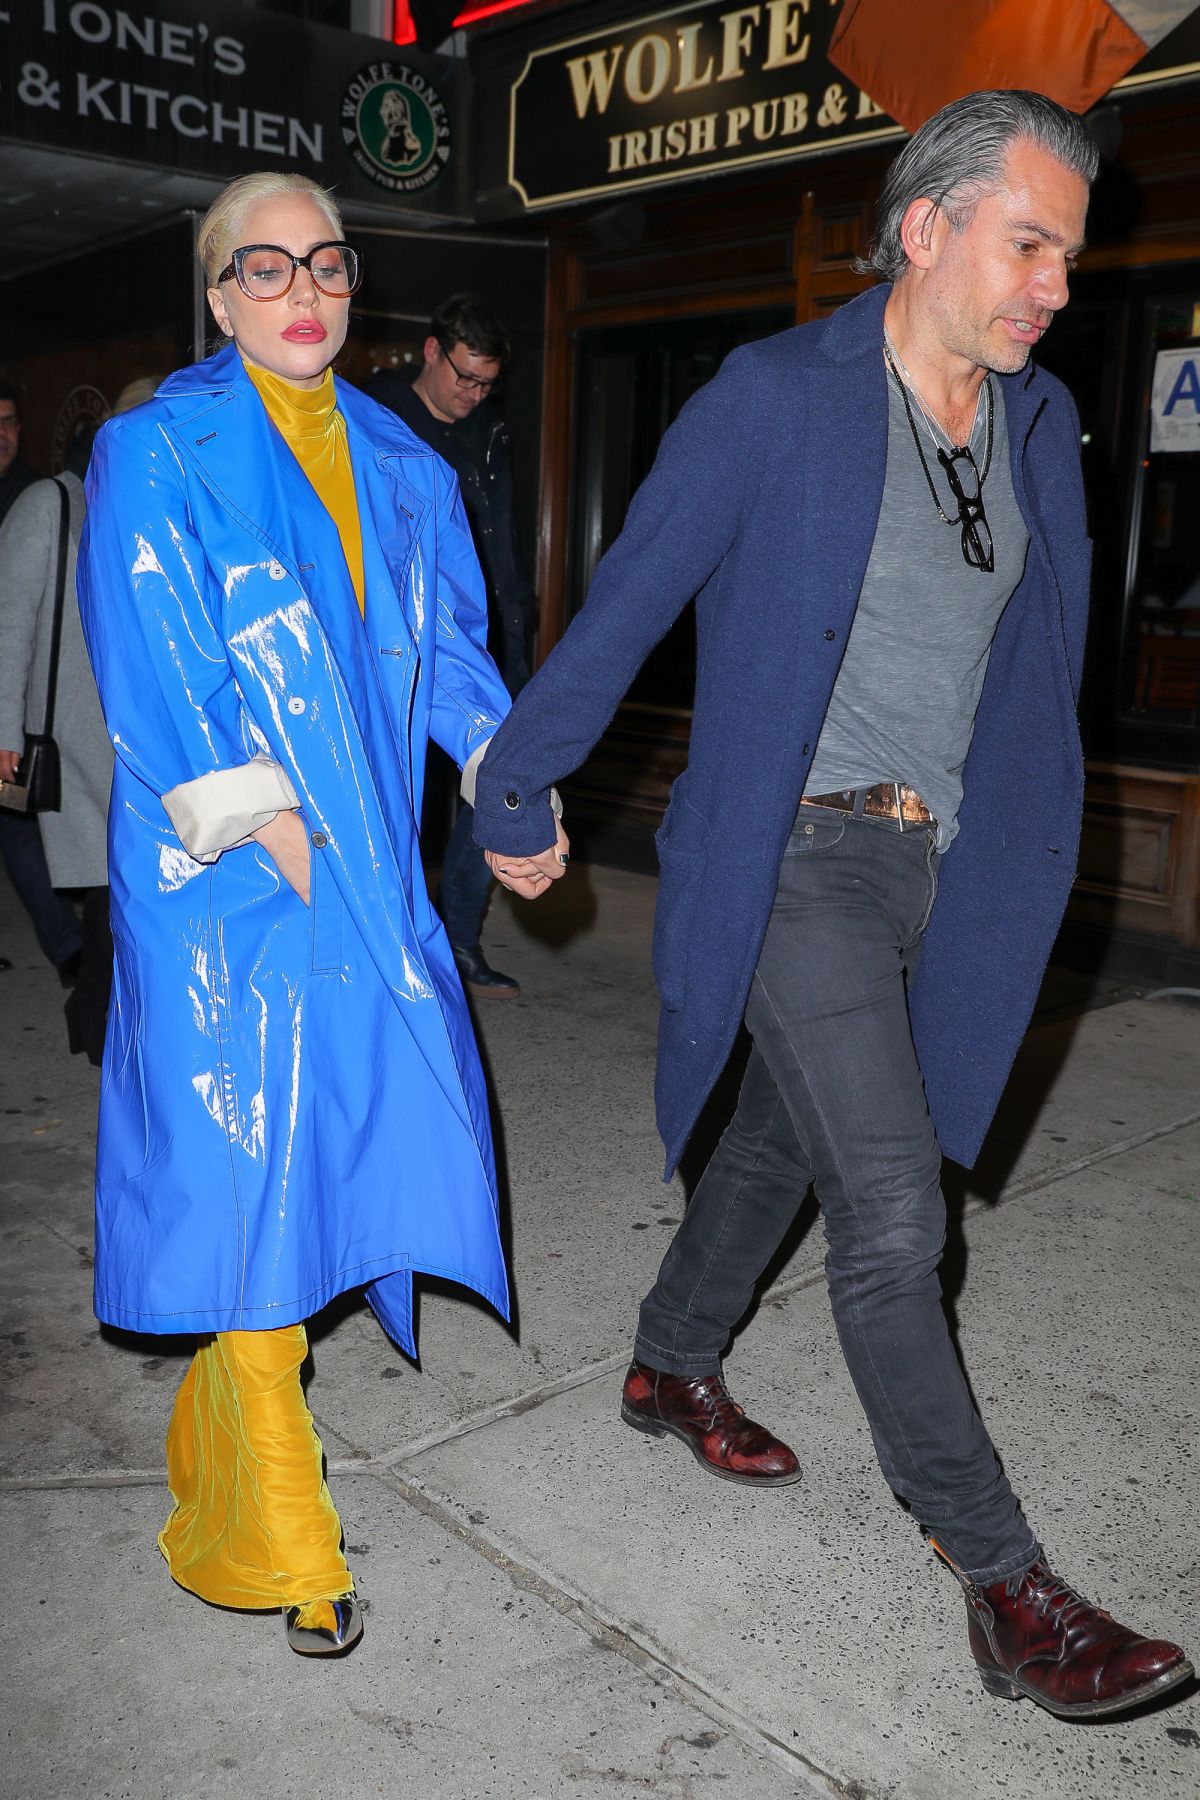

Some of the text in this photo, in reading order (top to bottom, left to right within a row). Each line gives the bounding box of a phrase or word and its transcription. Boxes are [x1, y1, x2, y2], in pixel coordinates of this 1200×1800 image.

[342, 62, 450, 137] WOLFE TONE'S
[566, 0, 811, 119] WOLFE
[17, 62, 323, 163] & KITCHEN
[608, 113, 718, 173] IRISH
[725, 92, 808, 148] PUB
[817, 83, 848, 128] &
[1161, 360, 1200, 417] A
